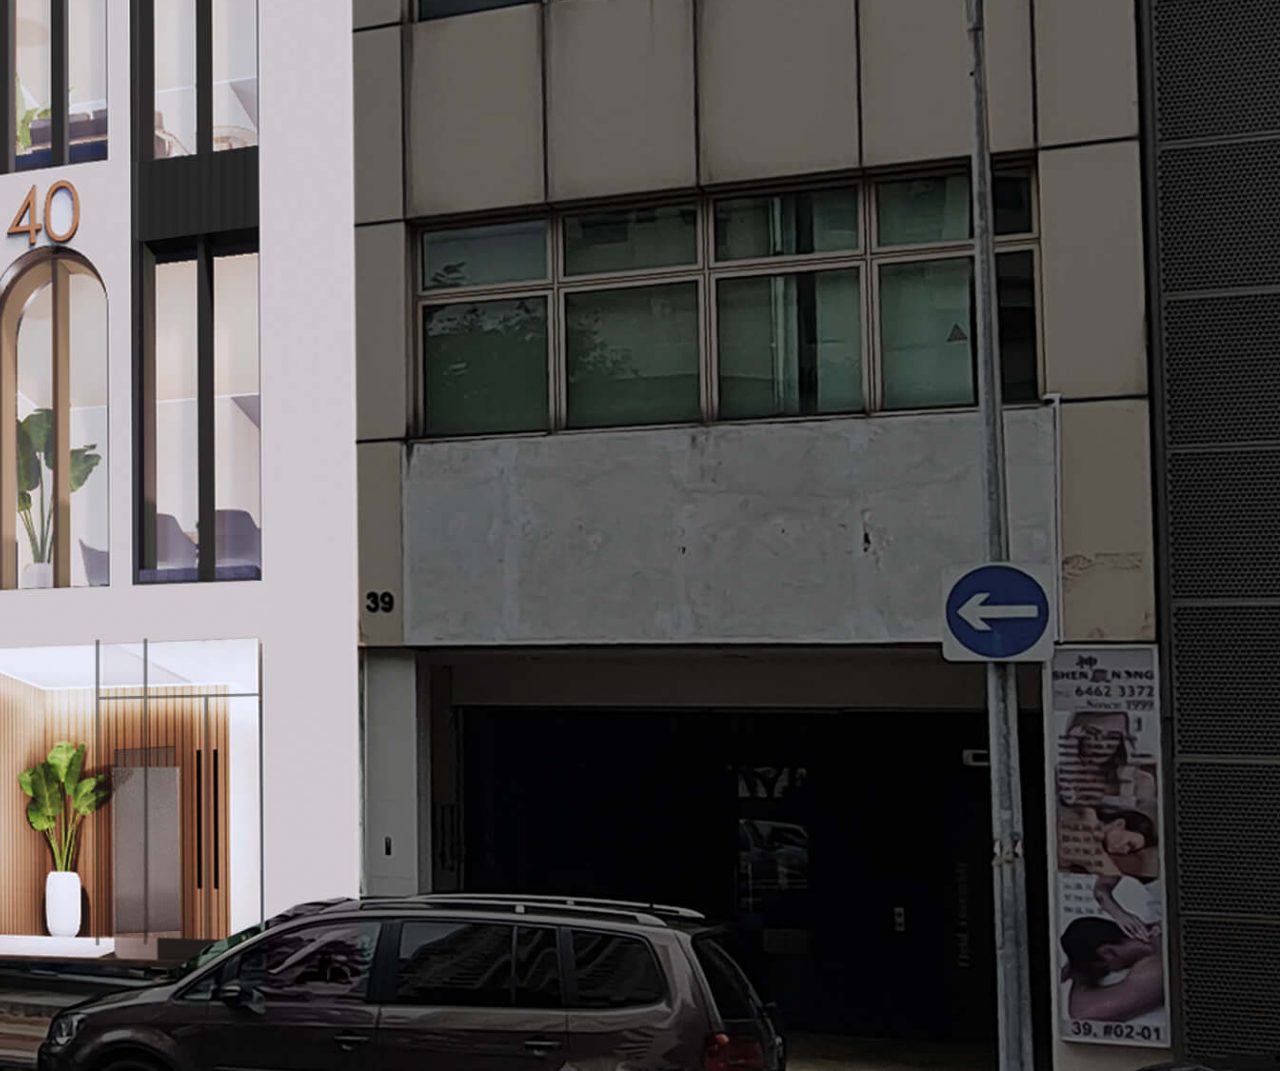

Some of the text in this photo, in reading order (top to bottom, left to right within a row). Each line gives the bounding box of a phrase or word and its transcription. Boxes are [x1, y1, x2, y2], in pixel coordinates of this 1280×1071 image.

[7, 180, 80, 246] 40
[366, 592, 394, 612] 39
[1075, 686, 1111, 696] 6462
[1119, 686, 1154, 696] 3372
[1103, 1024, 1161, 1041] #02-01
